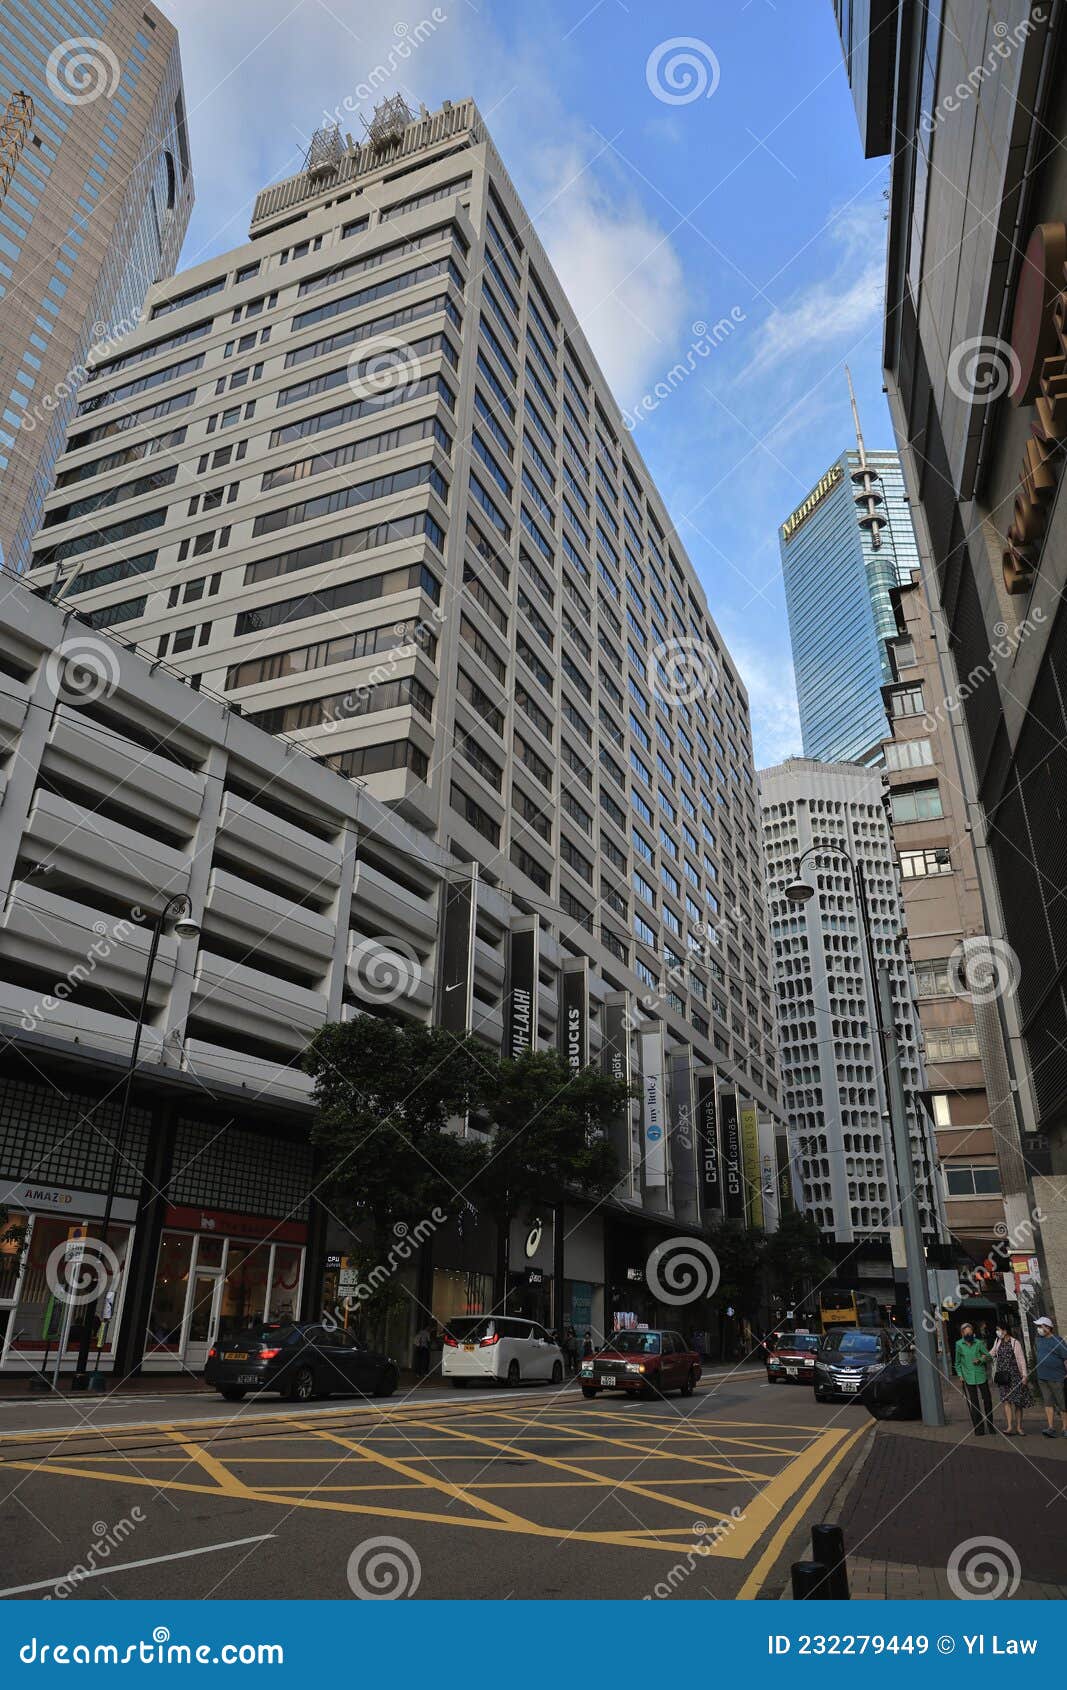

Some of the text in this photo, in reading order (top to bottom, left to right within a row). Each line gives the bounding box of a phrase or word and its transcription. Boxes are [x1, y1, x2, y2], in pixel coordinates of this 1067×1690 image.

[783, 466, 842, 540] Manulife
[568, 1008, 581, 1074] BUCKS
[612, 1052, 624, 1079] glöfs
[647, 1083, 656, 1106] little
[649, 1107, 658, 1122] my
[24, 1189, 72, 1205] AMAZED
